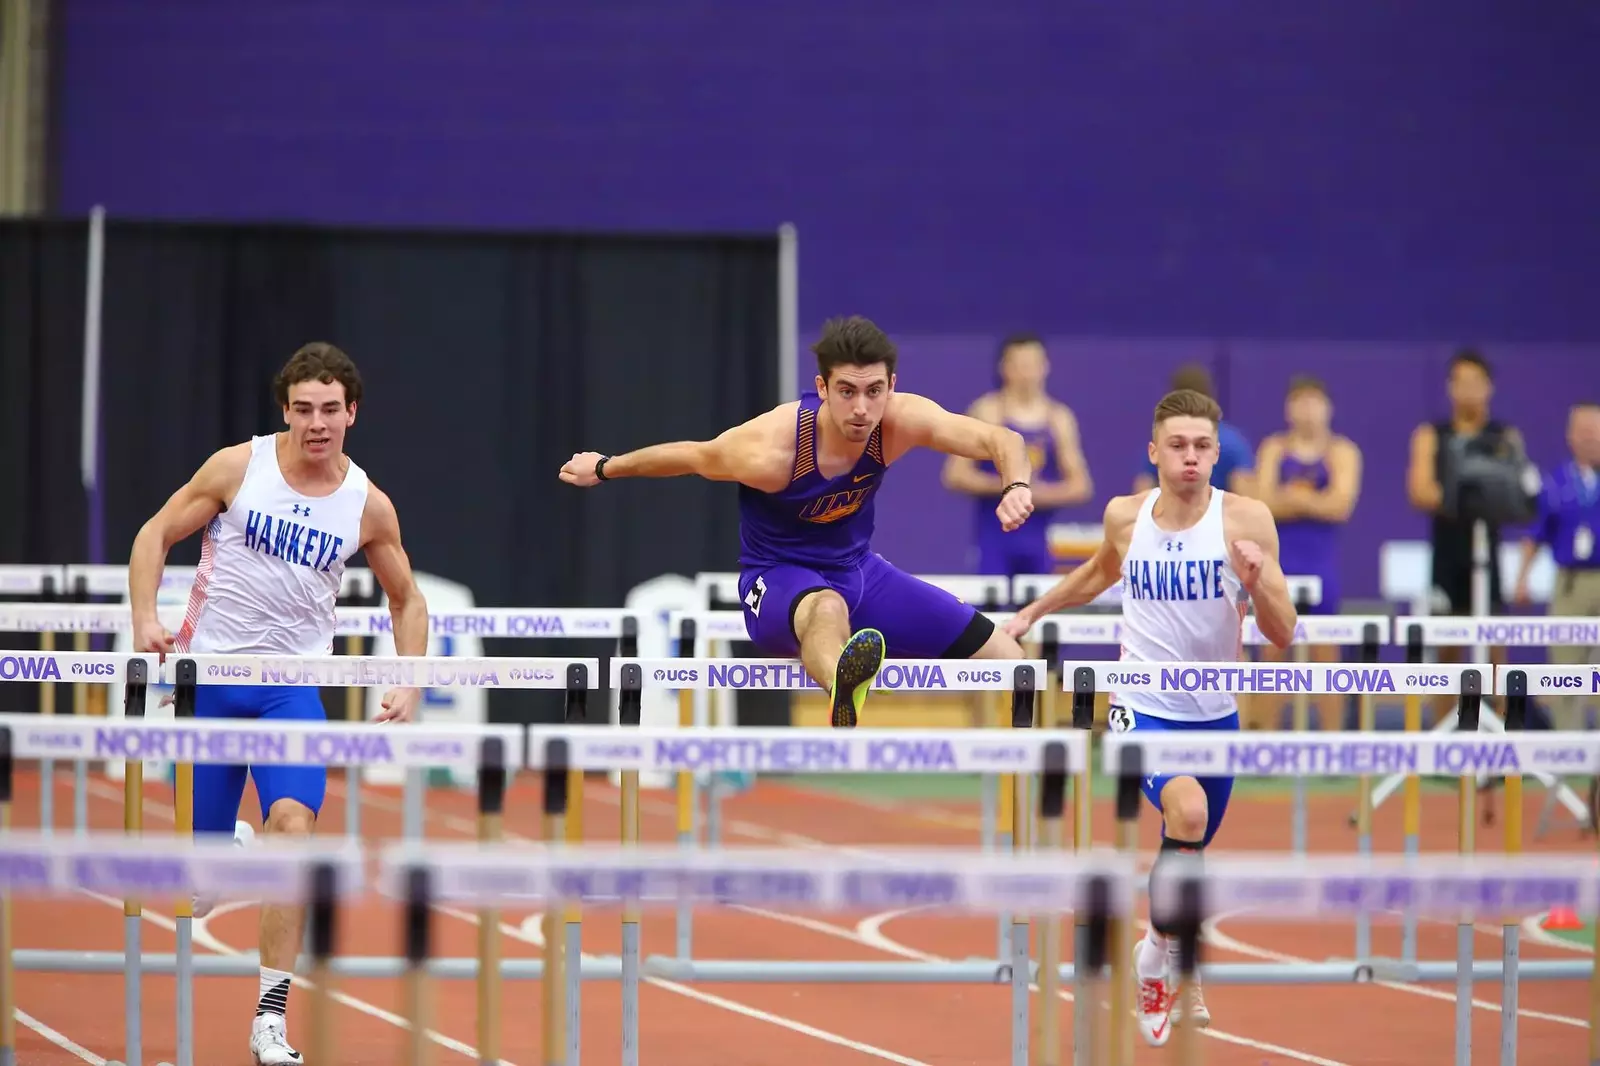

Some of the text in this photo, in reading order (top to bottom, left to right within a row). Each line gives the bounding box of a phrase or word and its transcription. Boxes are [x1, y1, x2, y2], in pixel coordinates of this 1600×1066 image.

[244, 510, 343, 572] HAWKEYE
[1130, 560, 1224, 600] HAWKEYE
[507, 615, 564, 634] IOWA
[1477, 624, 1598, 642] NORTHERN
[85, 663, 115, 676] UCS
[221, 661, 554, 686] UCS NORTHERN IOWA UCS
[667, 664, 1002, 688] UCS NORTH IOWA UCS
[1120, 669, 1449, 692] UCS NORTHERN IOWA UCS
[1553, 676, 1583, 688] UCS
[95, 729, 287, 760] NORTHERN
[303, 732, 394, 763] IOWA
[655, 739, 849, 768] NORTHERN
[867, 741, 957, 769] IOWA
[1226, 742, 1418, 771] NORTHERN
[1434, 743, 1521, 771] IOWA
